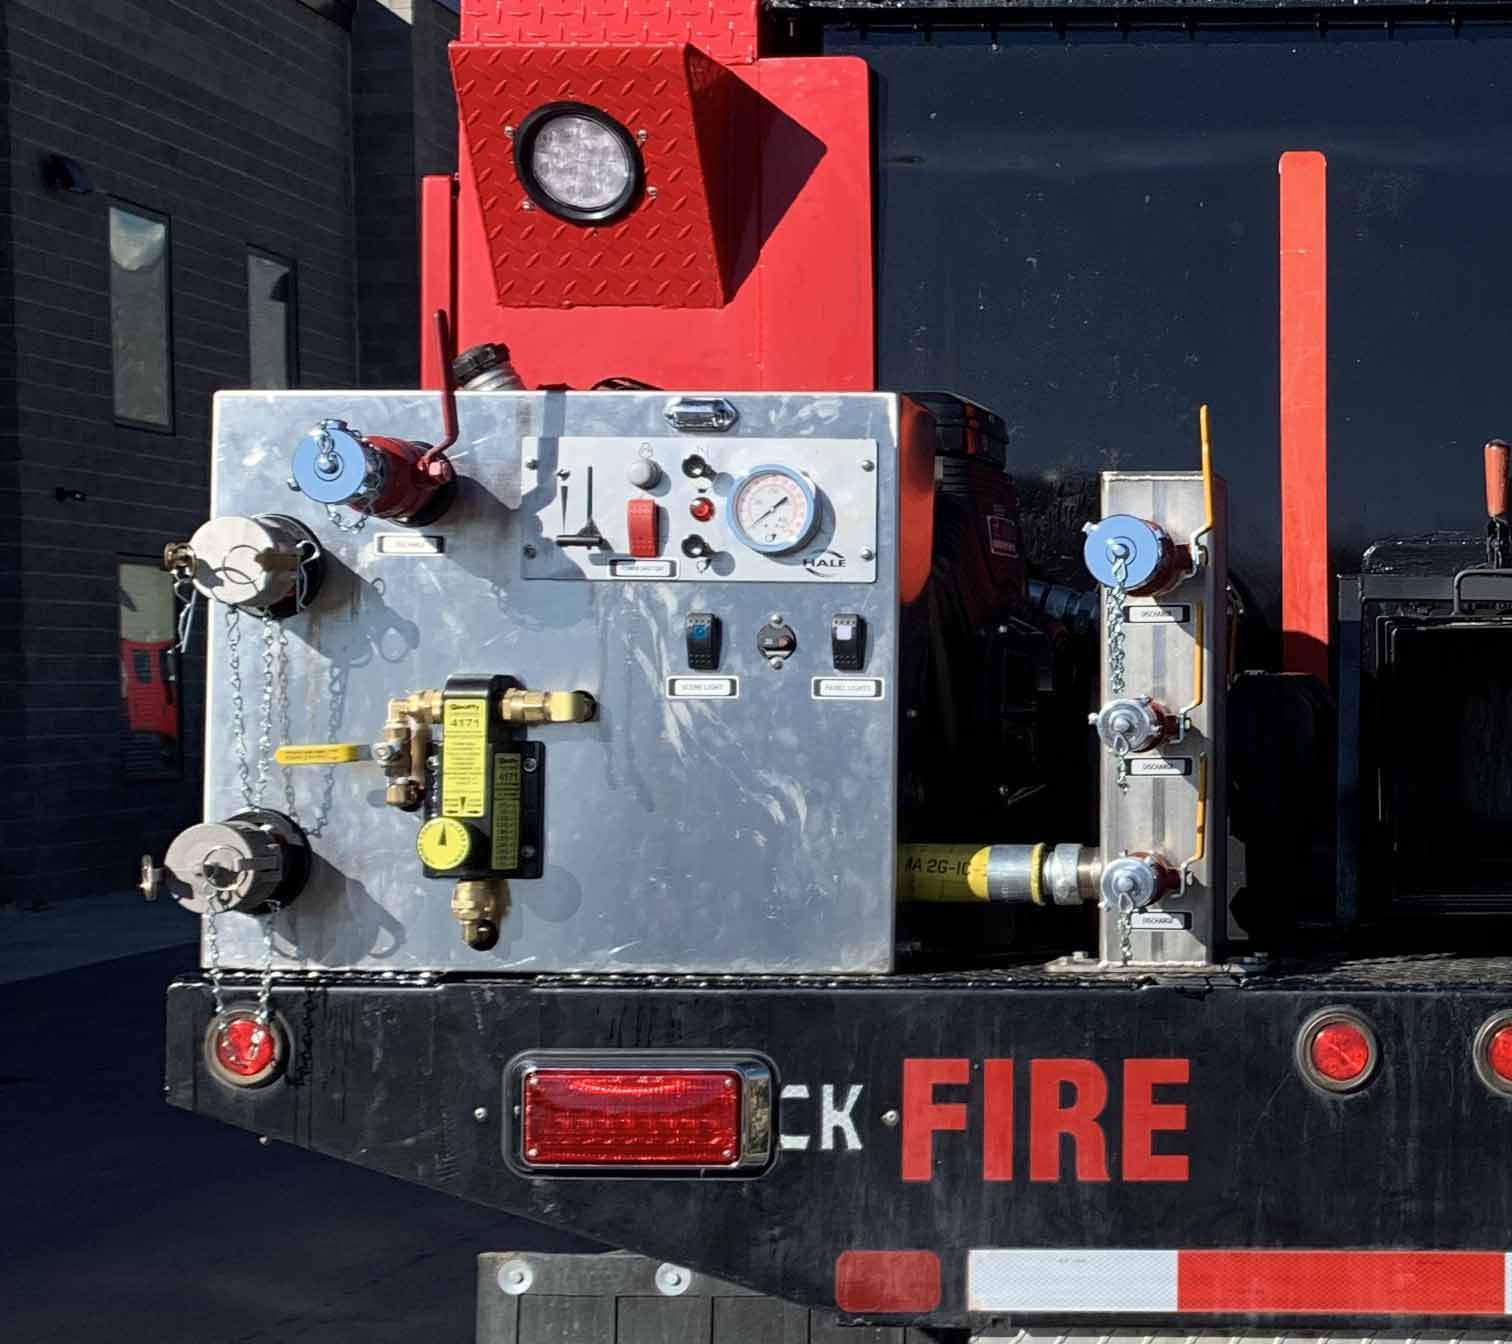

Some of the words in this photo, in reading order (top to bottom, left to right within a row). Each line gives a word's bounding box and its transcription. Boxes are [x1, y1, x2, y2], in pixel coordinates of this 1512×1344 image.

[802, 559, 847, 568] HALE
[449, 719, 480, 728] 4171
[902, 1057, 1191, 1183] FIRE
